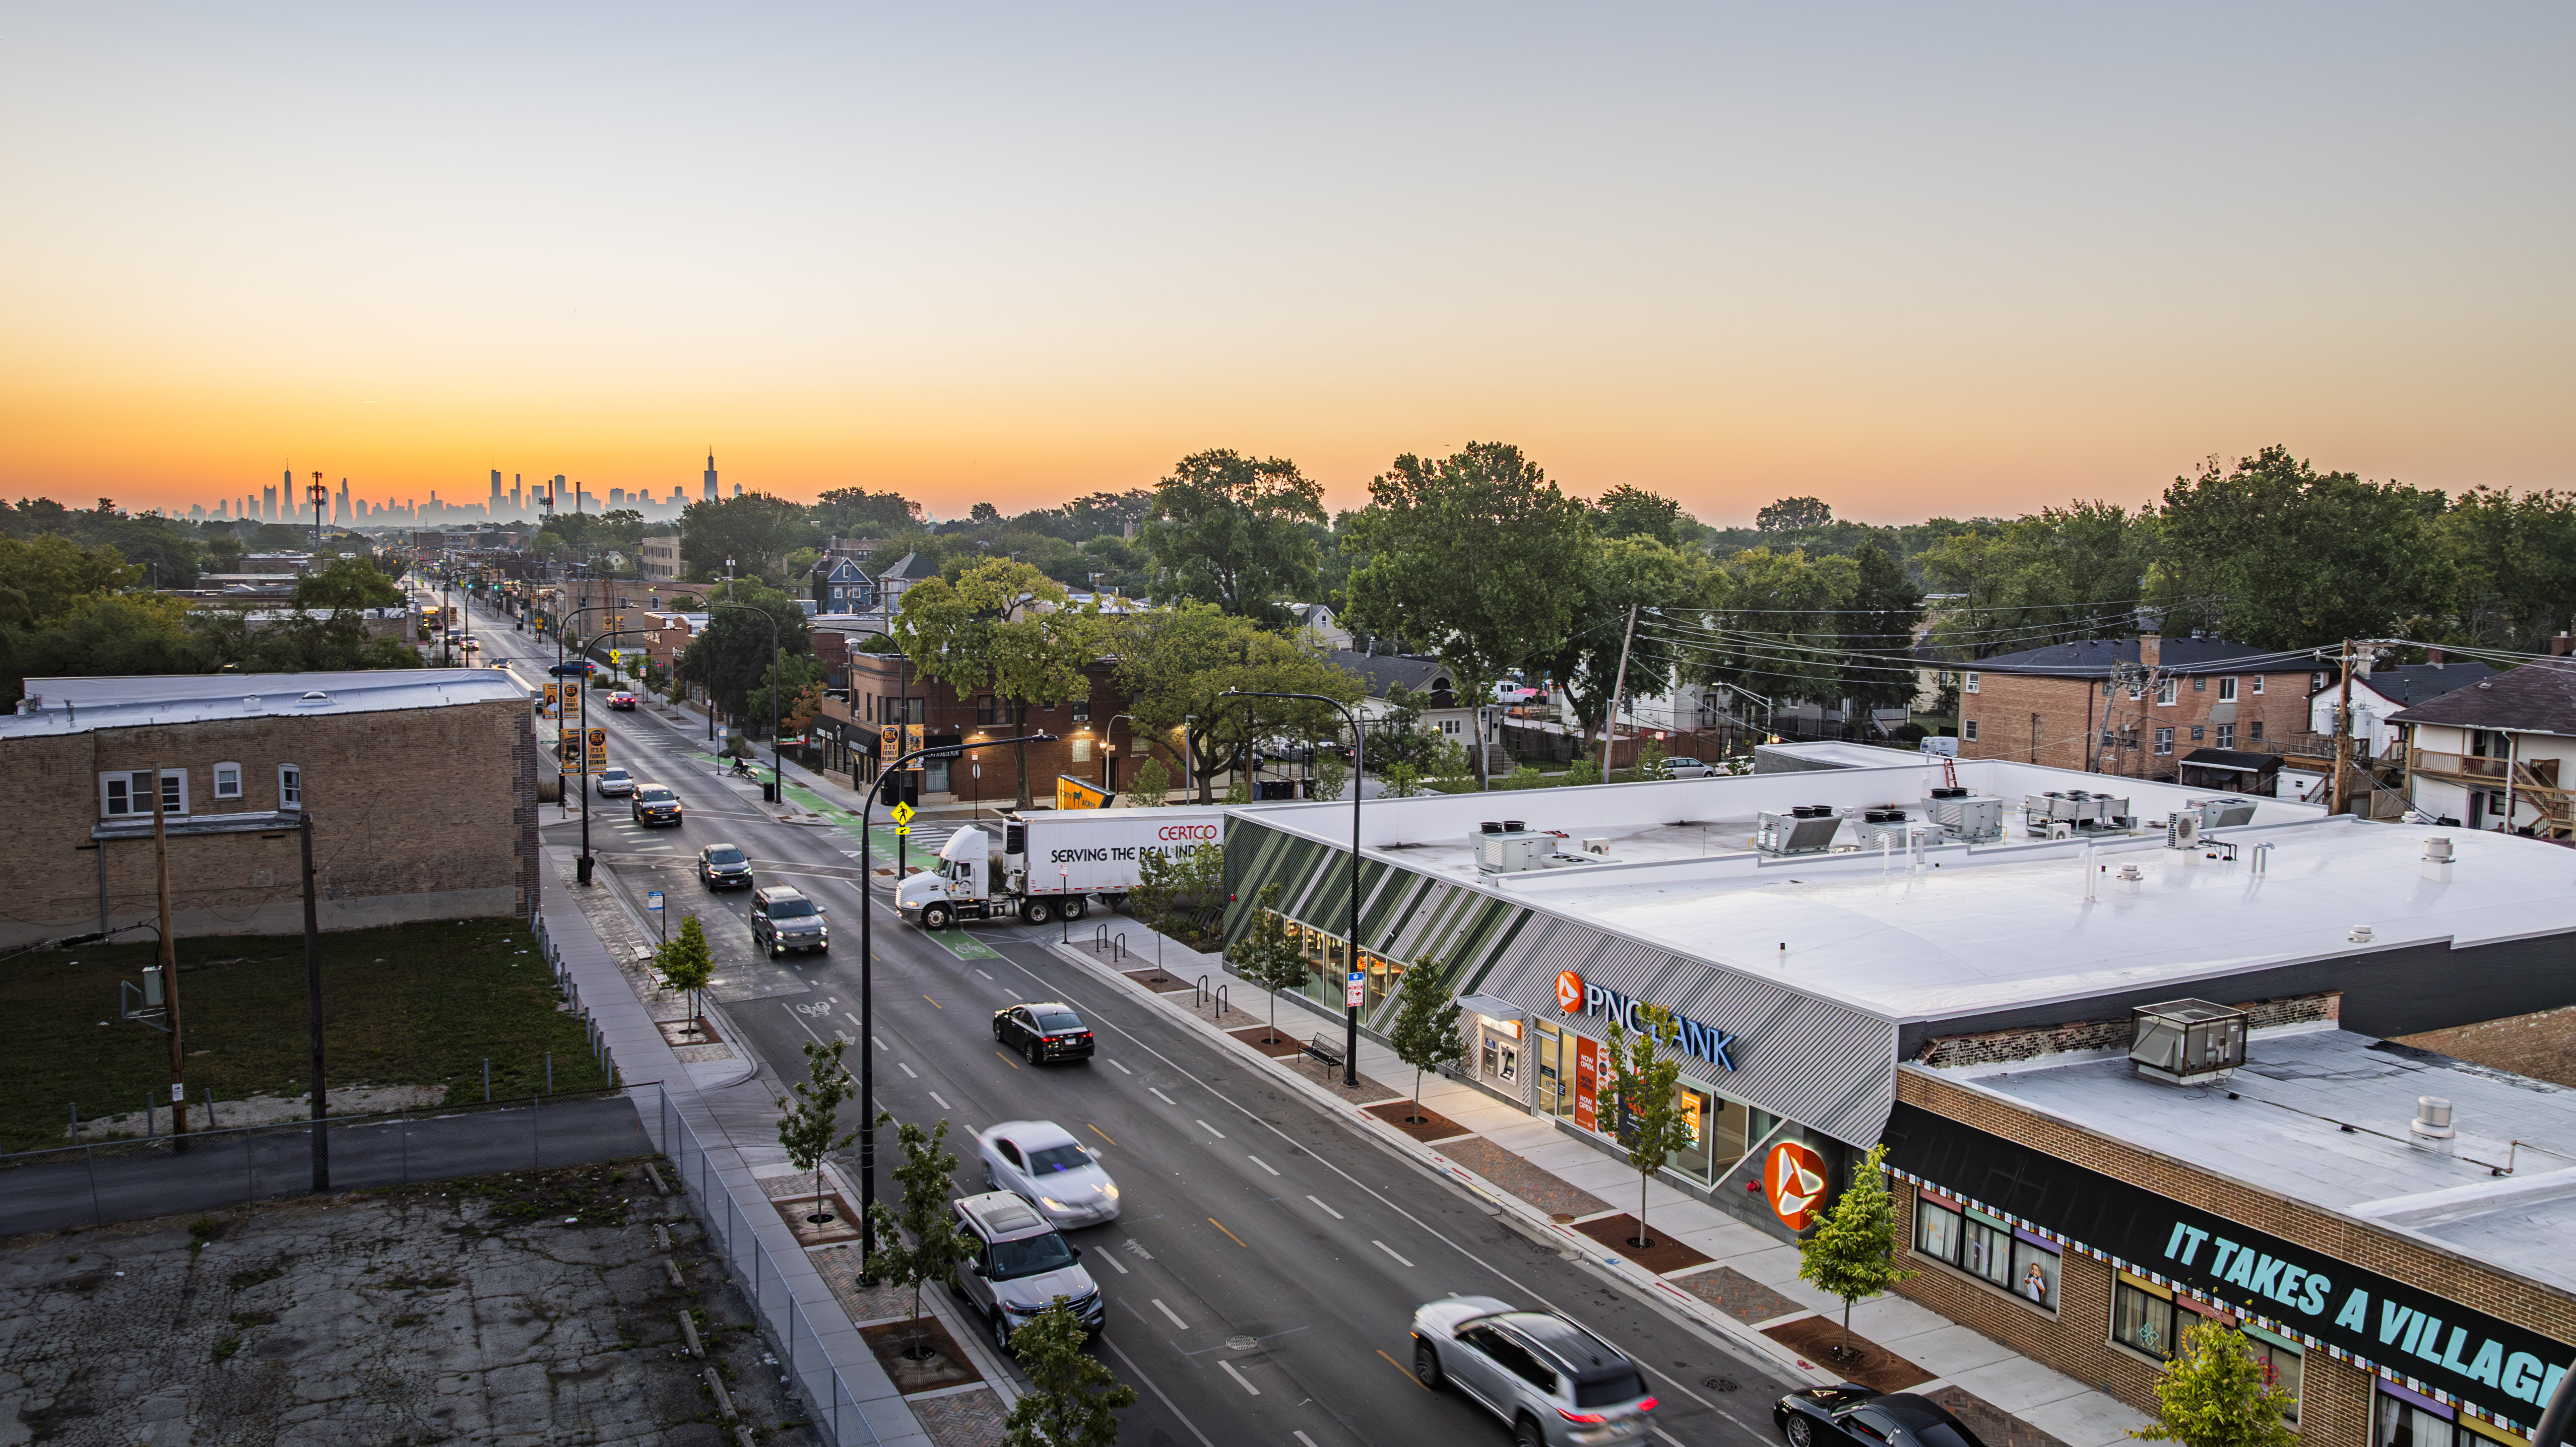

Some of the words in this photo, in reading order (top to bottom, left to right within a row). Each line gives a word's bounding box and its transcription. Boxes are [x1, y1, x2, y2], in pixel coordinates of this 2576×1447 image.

[1082, 799, 1096, 809] ACRES
[1158, 825, 1217, 841] CERTCO
[1051, 848, 1108, 863] SERVING
[1111, 847, 1135, 861] THE
[1584, 982, 1645, 1036] PNC
[1581, 1054, 1593, 1064] NOW
[1599, 1051, 1608, 1059] 400
[1580, 1061, 1595, 1072] OPEN.
[1580, 1075, 1593, 1085] NOW
[1580, 1095, 1592, 1105] NOW
[1579, 1101, 1593, 1113] OPEN.
[2164, 1221, 2210, 1267] IT
[2210, 1236, 2332, 1316] TAKES
[2335, 1287, 2370, 1334] A
